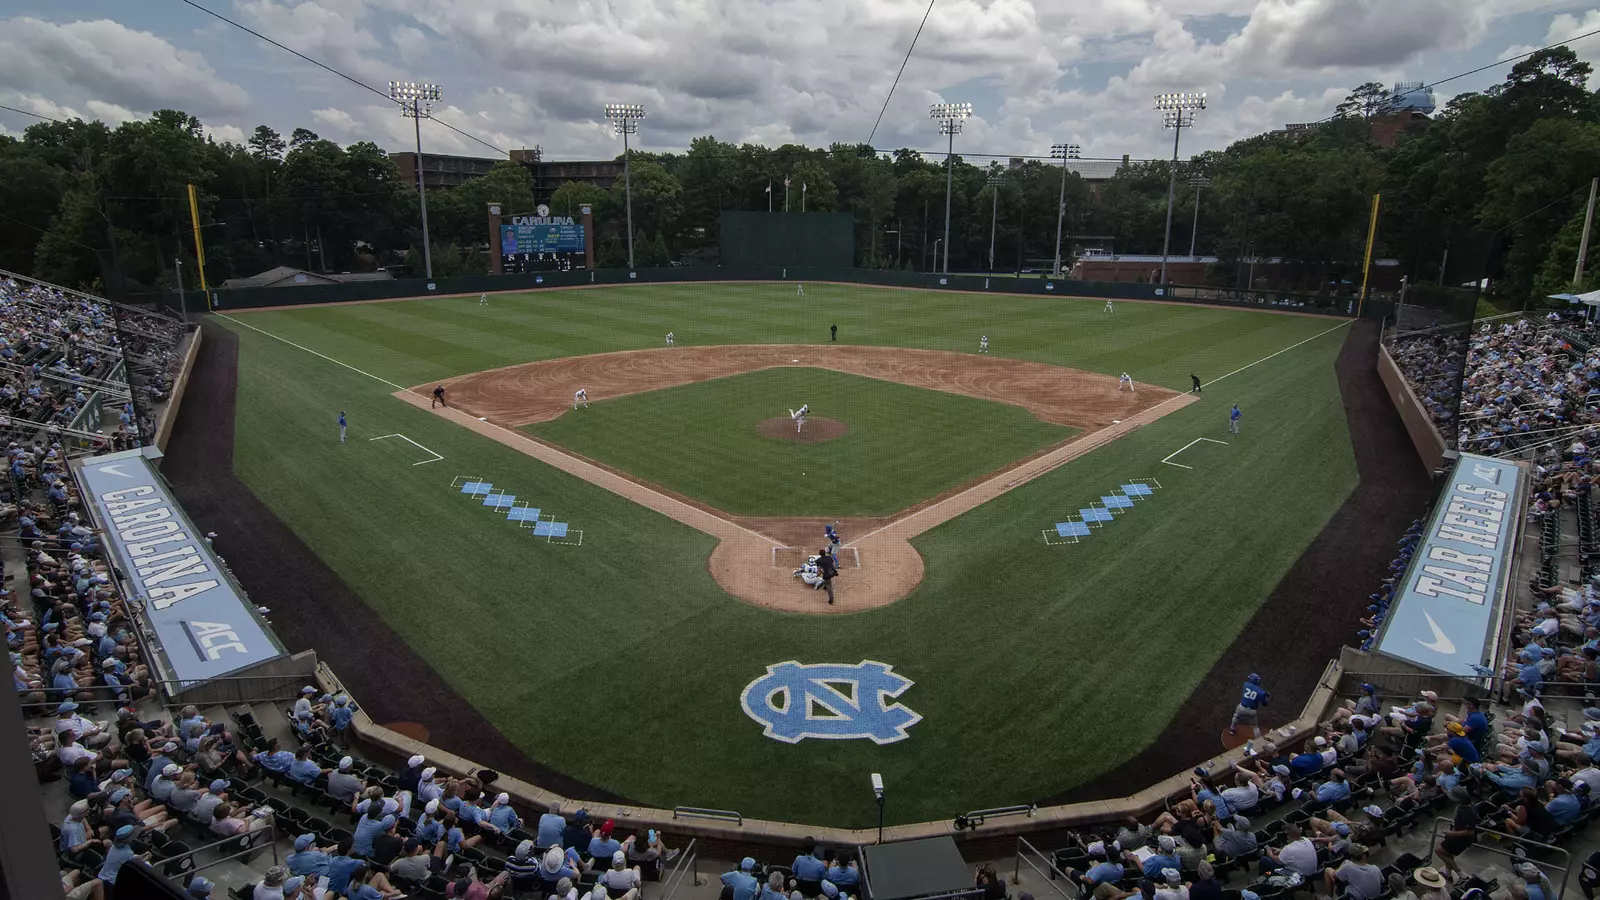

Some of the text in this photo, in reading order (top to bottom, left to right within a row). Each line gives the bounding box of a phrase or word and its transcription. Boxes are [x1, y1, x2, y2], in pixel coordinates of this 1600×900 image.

[512, 216, 575, 226] CAROLINA
[100, 485, 221, 611] CAROLINA
[1413, 483, 1508, 605] TAR HEELS
[190, 620, 249, 661] ACC
[1243, 688, 1258, 700] 20
